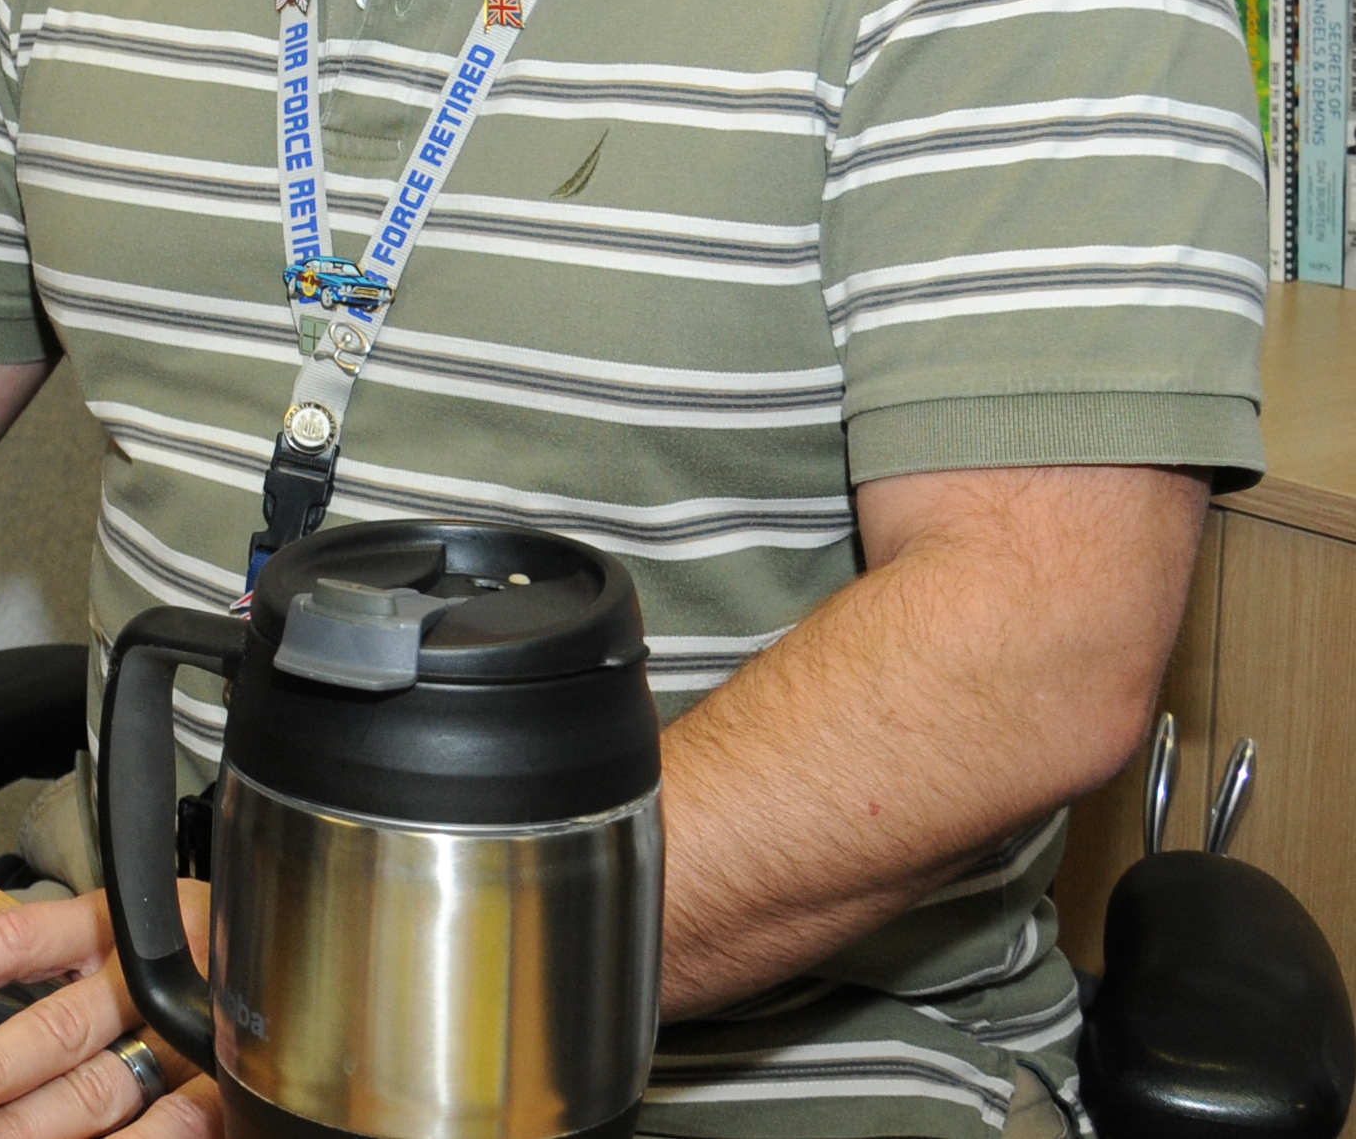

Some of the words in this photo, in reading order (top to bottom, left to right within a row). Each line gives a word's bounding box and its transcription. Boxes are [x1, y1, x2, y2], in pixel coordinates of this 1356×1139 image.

[285, 22, 308, 71] AIR
[1313, 60, 1327, 72] &
[1328, 22, 1342, 94] SECRETS
[284, 76, 313, 171] FORCE
[1313, 77, 1327, 147] DEMONS
[1328, 98, 1342, 121] OF
[373, 170, 435, 267] FORCE
[420, 44, 496, 167] RETIRED
[288, 178, 323, 263] RETIR
